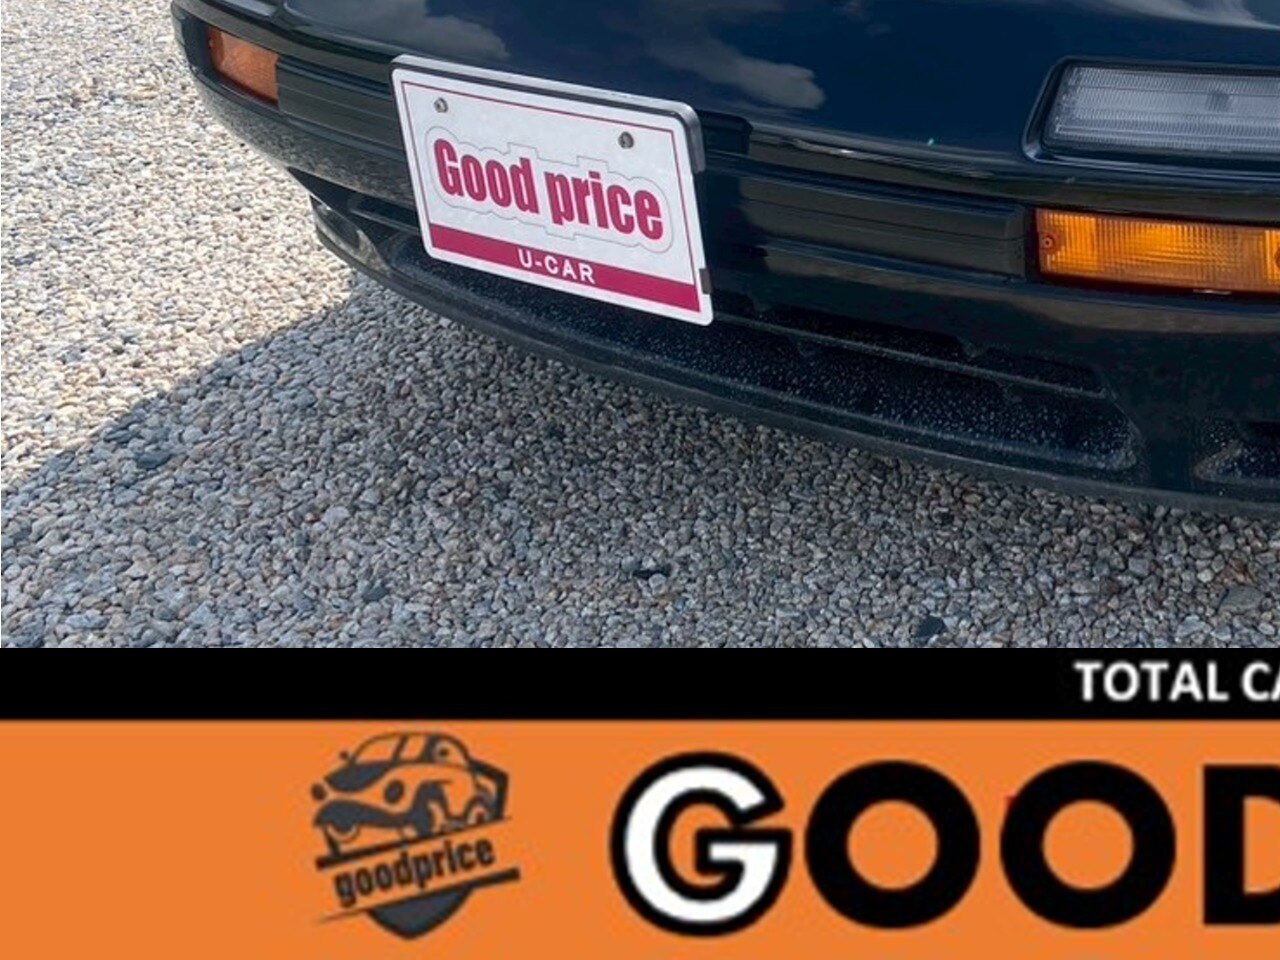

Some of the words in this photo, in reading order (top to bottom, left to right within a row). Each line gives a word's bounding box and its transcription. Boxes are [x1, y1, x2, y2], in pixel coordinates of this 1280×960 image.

[433, 138, 540, 215] Good
[545, 170, 665, 241] price
[517, 249, 597, 284] U-CAR
